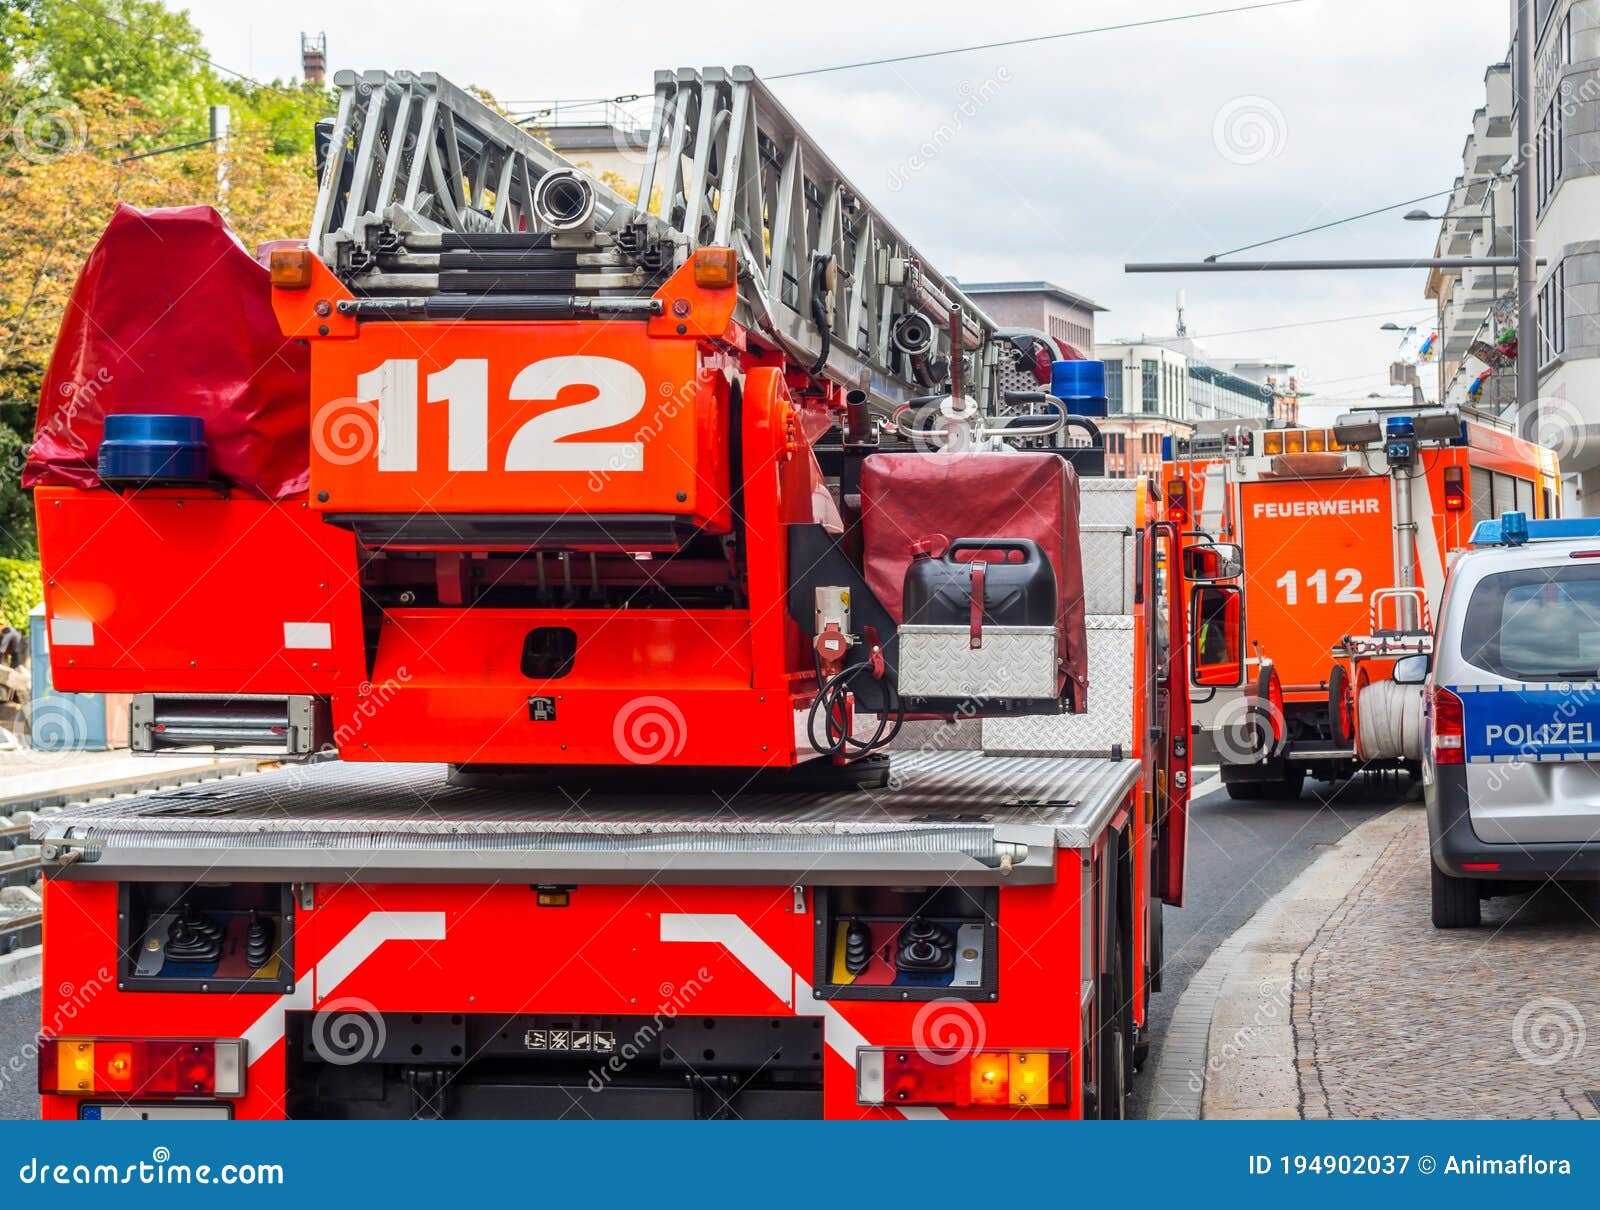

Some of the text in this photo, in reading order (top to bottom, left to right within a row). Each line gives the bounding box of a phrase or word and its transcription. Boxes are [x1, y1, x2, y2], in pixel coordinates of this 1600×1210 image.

[357, 355, 646, 472] 112
[1253, 498, 1380, 518] FEUERWEHR
[1276, 568, 1364, 605] 112
[1486, 721, 1594, 746] POLIZEI
